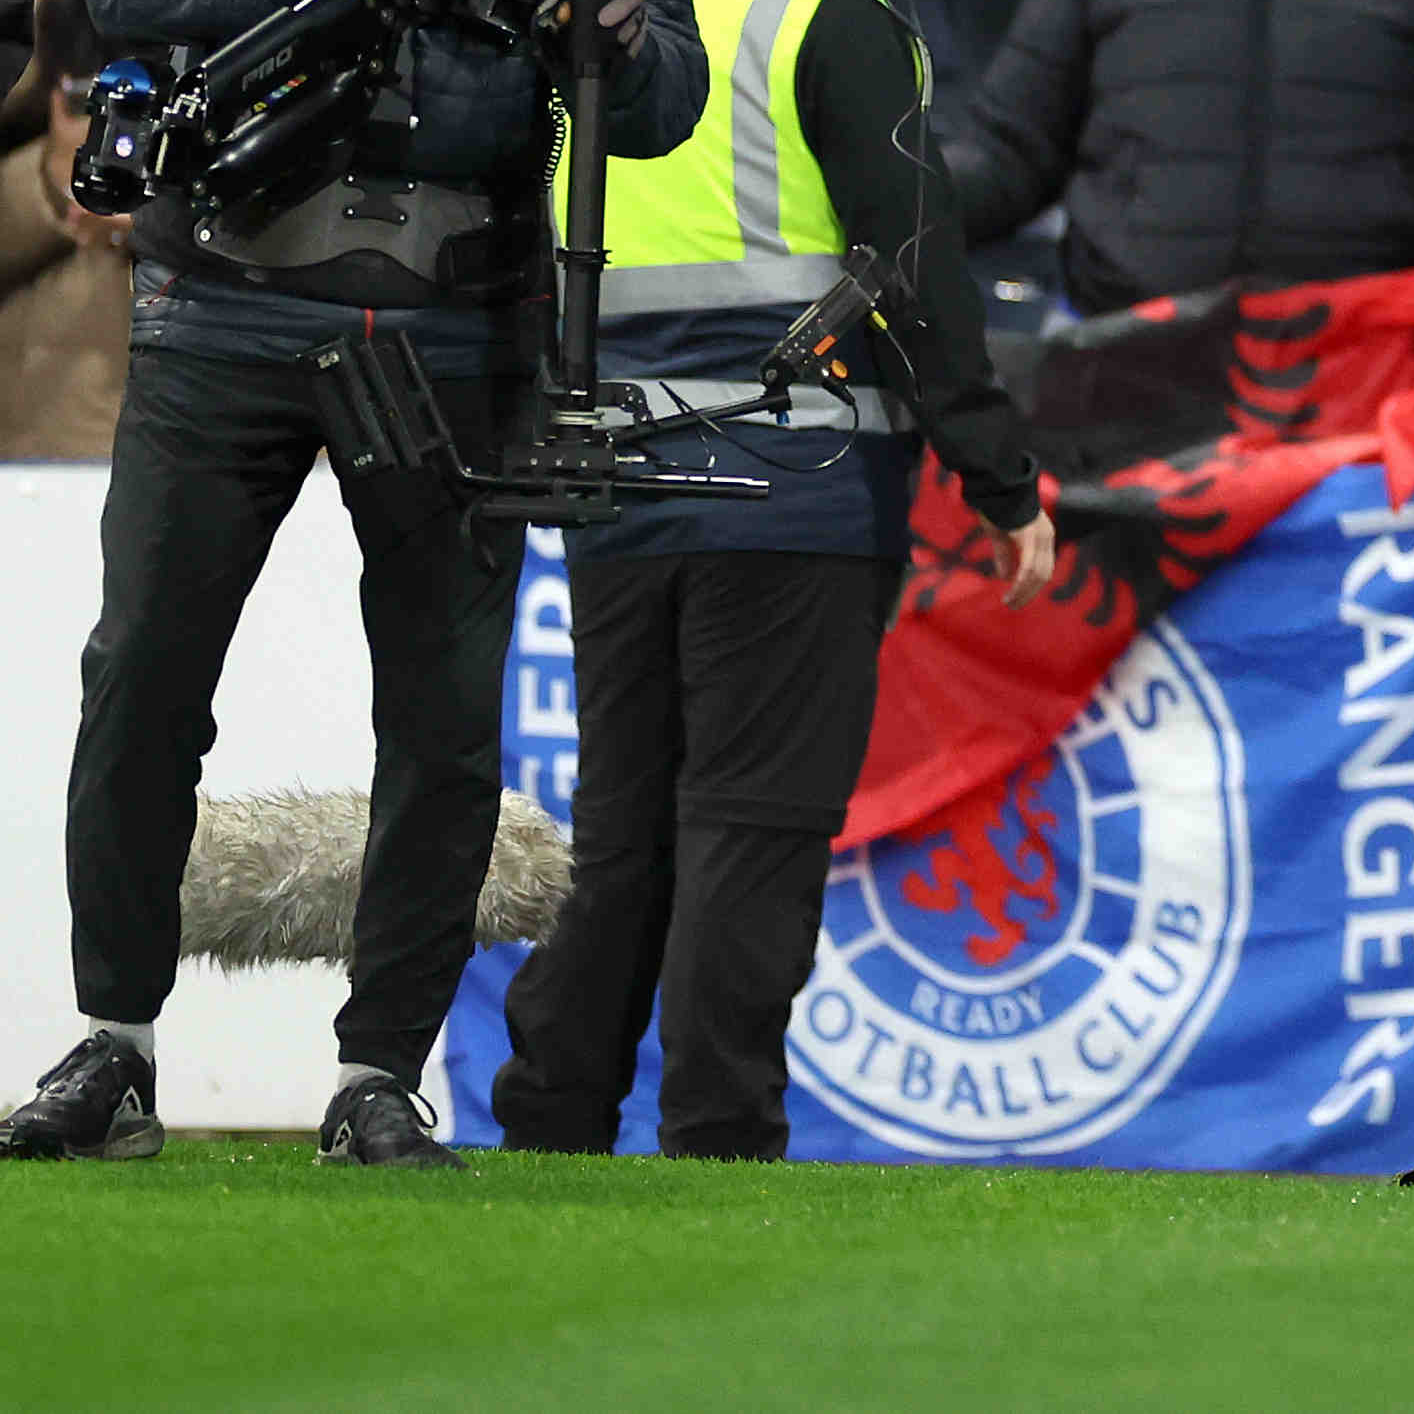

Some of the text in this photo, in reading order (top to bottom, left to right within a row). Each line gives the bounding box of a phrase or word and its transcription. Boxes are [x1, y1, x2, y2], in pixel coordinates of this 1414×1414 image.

[807, 899, 1203, 1118] OTBALL CLUB
[907, 981, 1047, 1036] READY
